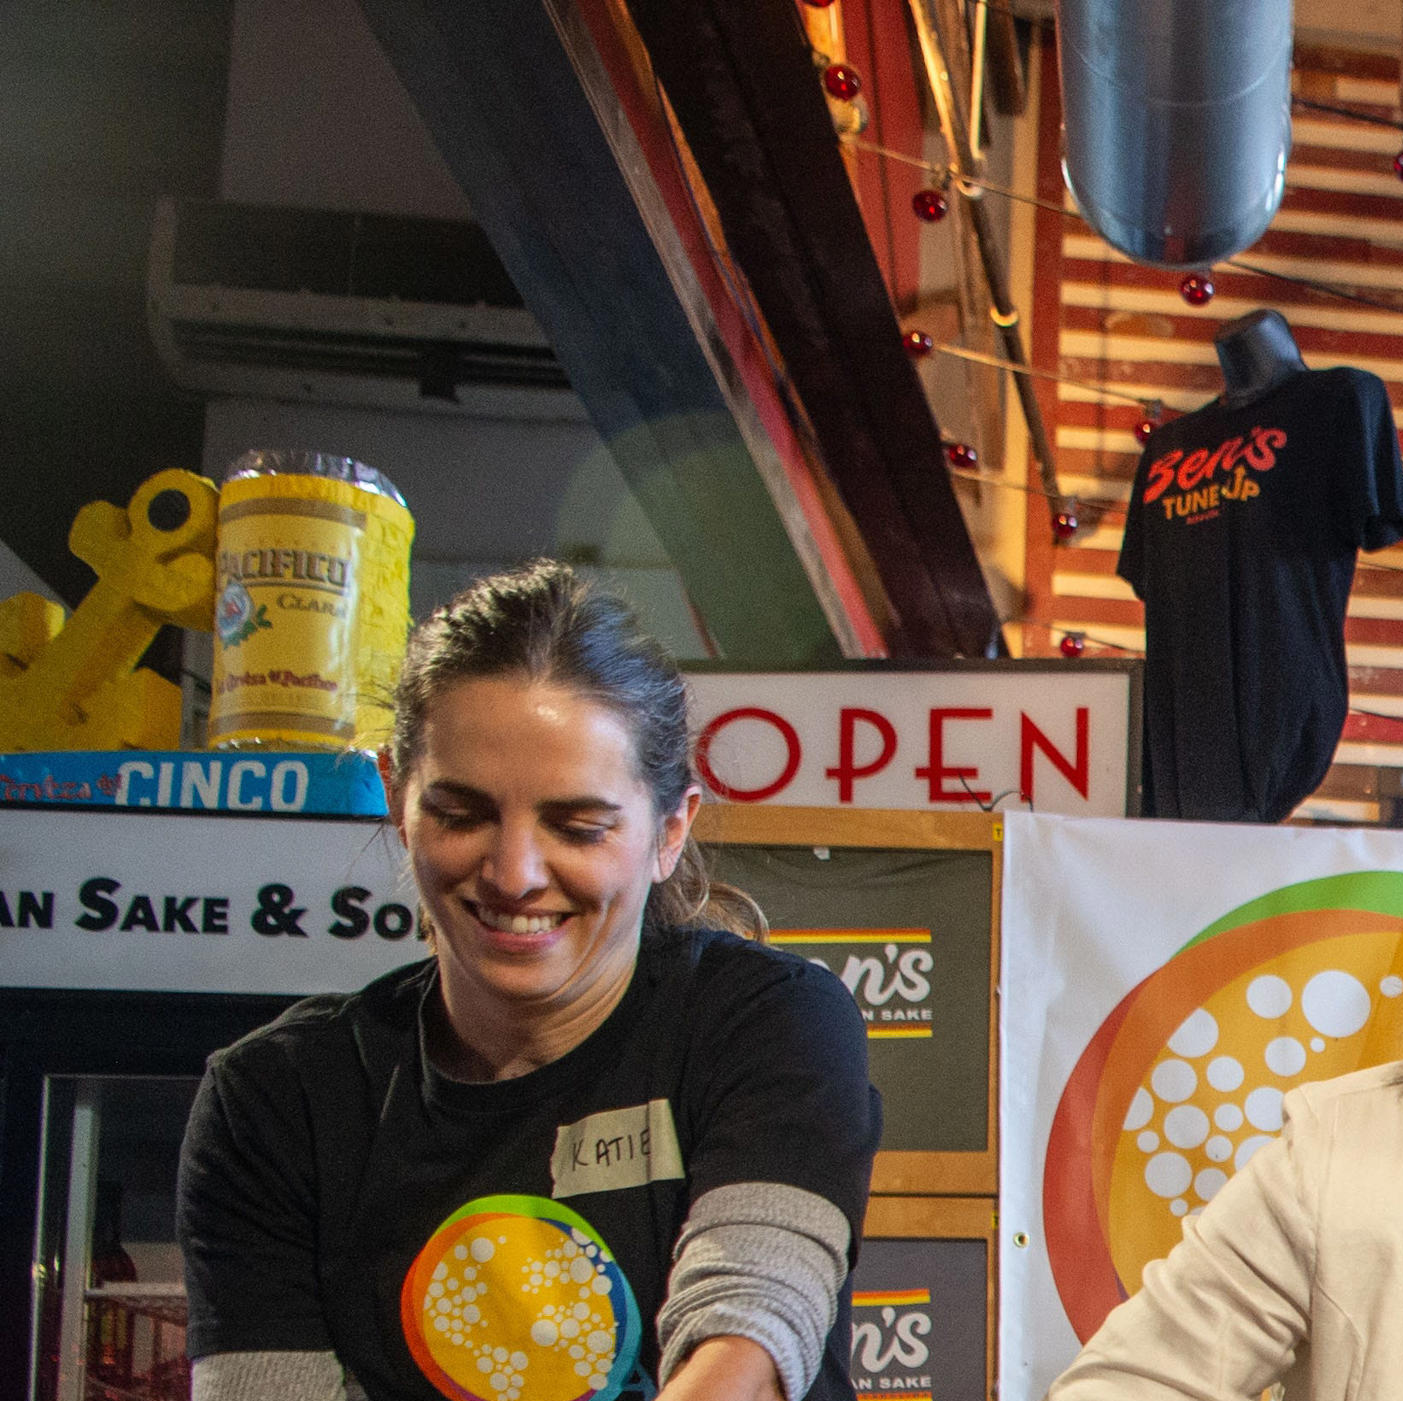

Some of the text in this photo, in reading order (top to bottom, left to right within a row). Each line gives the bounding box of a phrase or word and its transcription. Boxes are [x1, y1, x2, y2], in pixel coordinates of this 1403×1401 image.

[1162, 484, 1220, 519] TUNE
[697, 707, 1089, 802] OPEN
[115, 760, 310, 812] CINCO
[251, 883, 308, 938] &
[880, 1009, 933, 1021] SAKE
[571, 1129, 651, 1171] KATIE
[879, 1376, 932, 1389] SAKE
